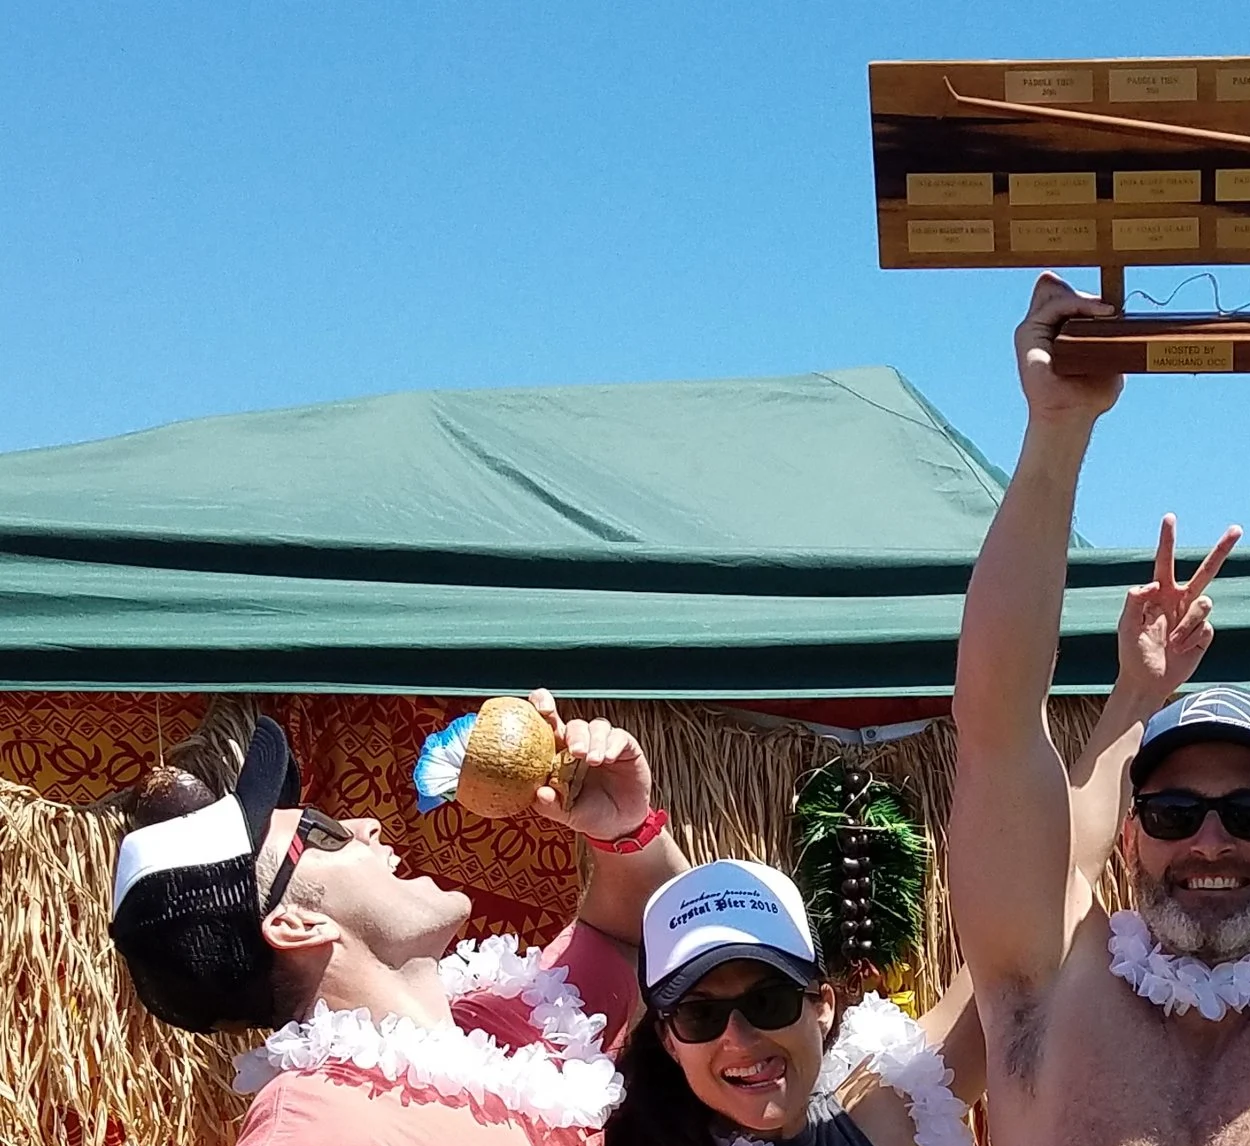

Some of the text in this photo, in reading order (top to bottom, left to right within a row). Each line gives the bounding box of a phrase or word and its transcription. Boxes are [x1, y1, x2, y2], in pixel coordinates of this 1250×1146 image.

[1164, 345, 1216, 354] HOSTED BY
[669, 898, 779, 929] Crystal Pier 2018
